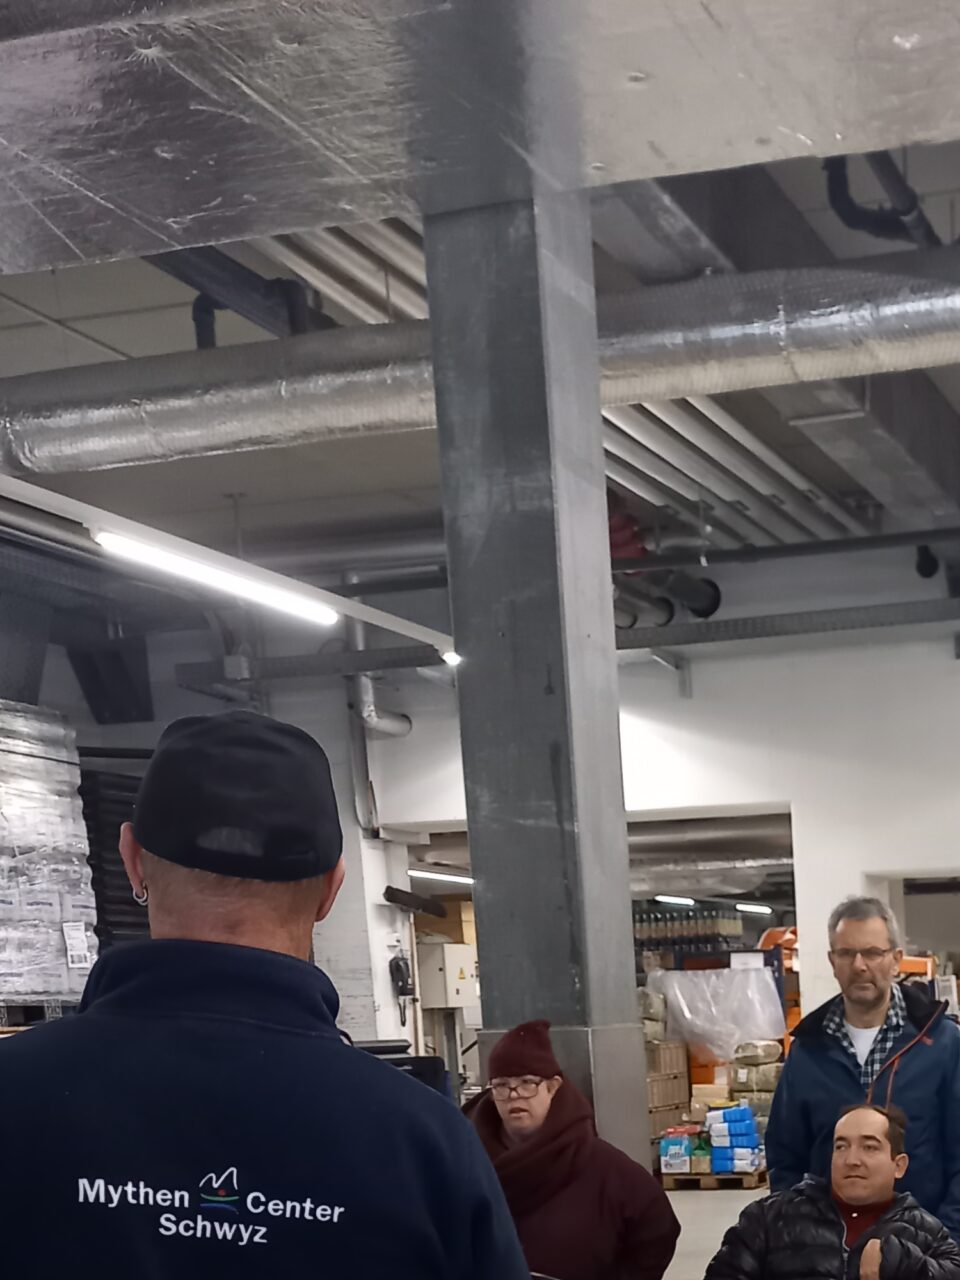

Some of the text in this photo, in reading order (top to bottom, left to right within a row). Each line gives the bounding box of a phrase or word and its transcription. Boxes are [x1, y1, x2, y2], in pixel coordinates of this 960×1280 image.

[78, 1178, 345, 1223] Mythen Center
[158, 1213, 268, 1246] Schwyz
